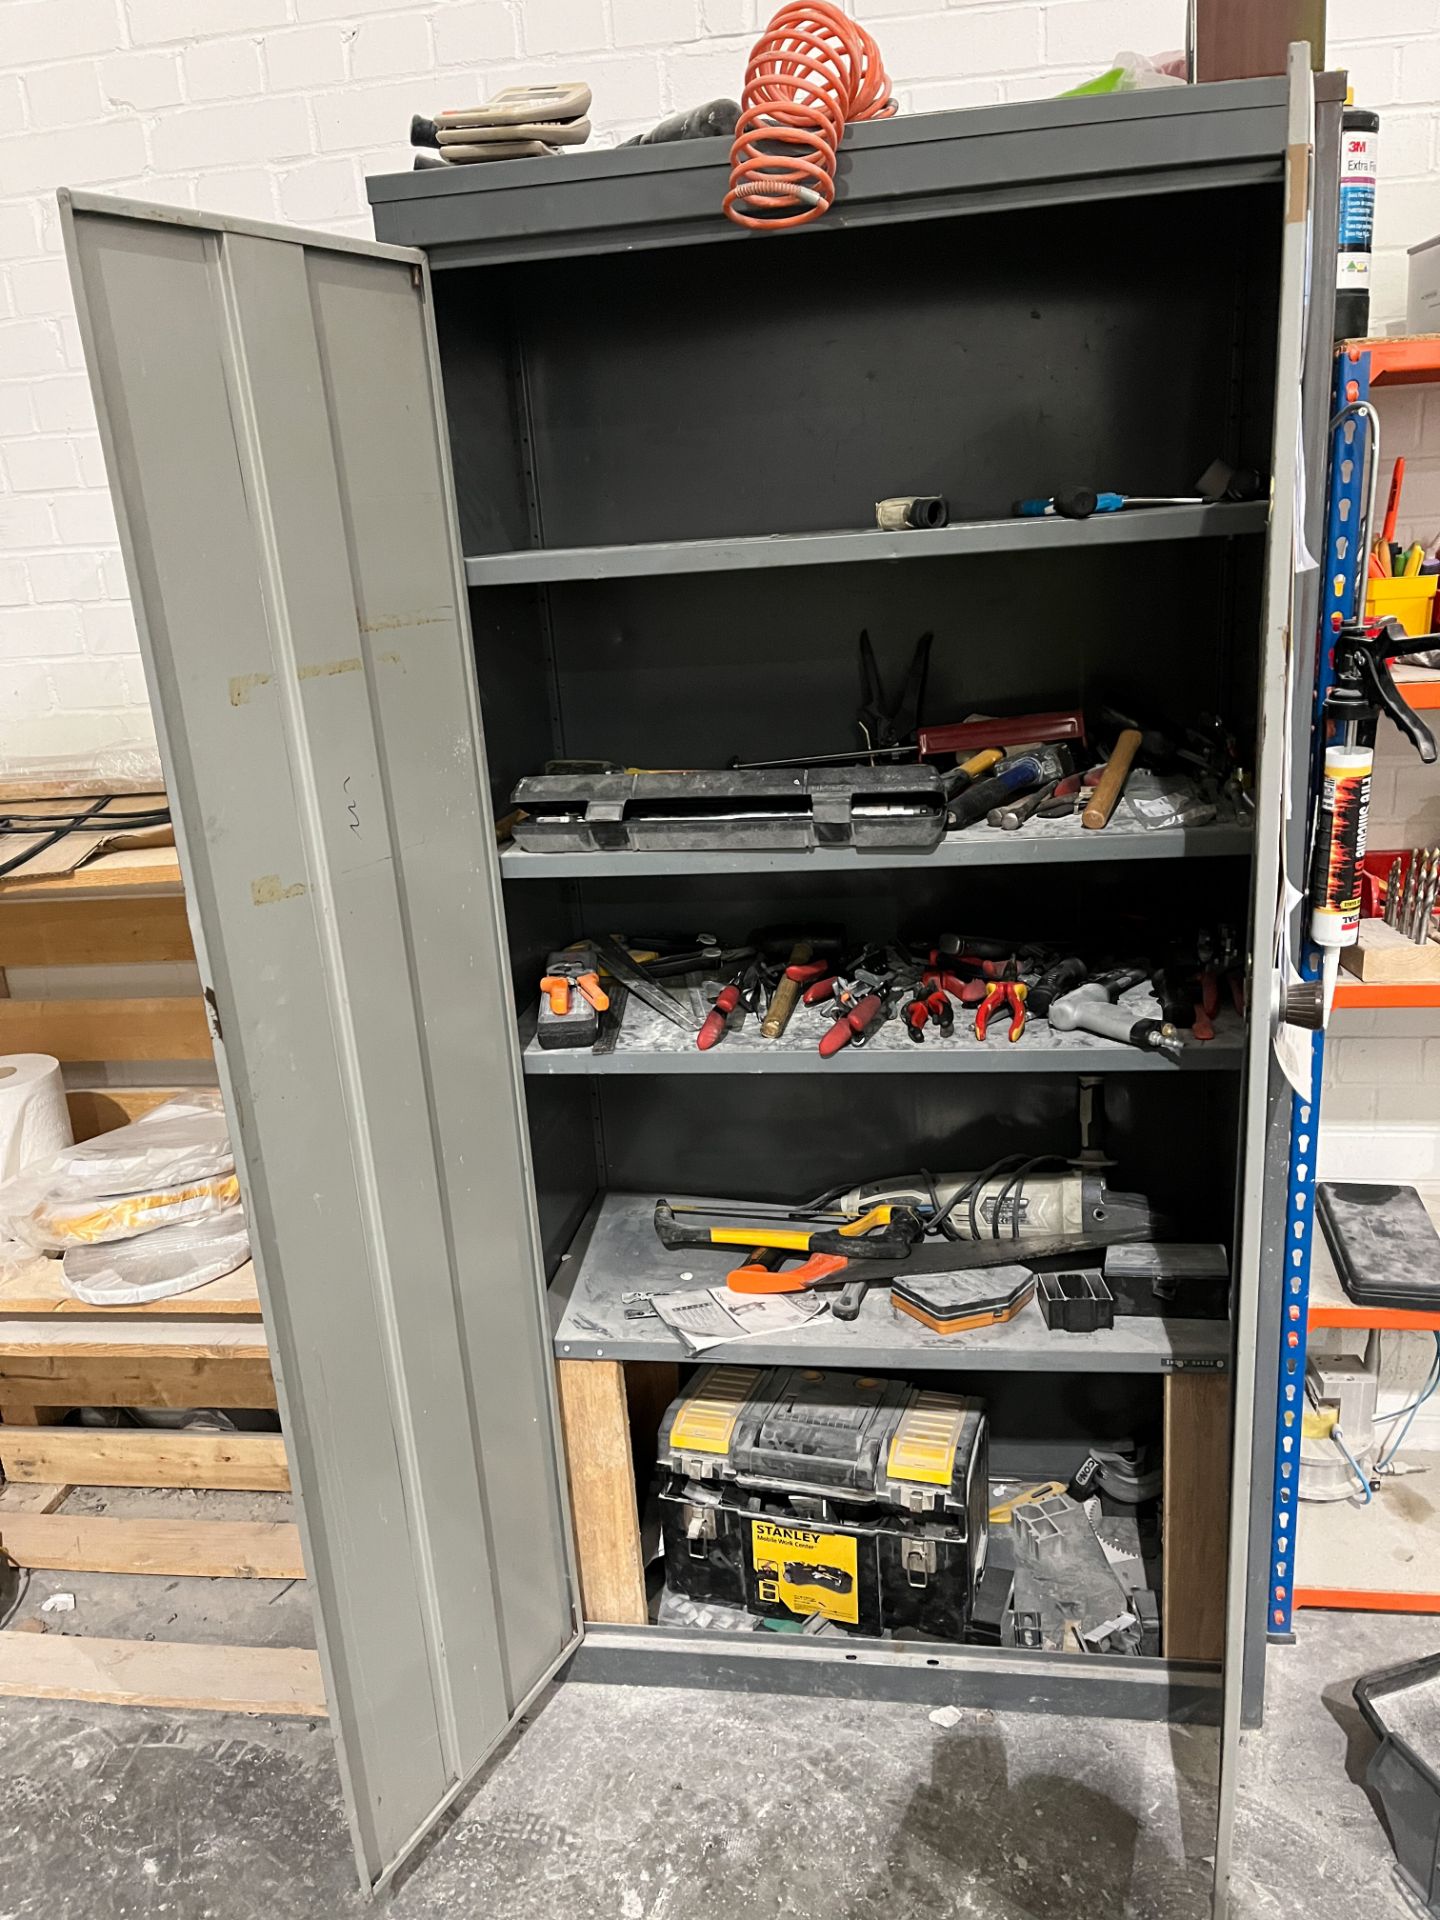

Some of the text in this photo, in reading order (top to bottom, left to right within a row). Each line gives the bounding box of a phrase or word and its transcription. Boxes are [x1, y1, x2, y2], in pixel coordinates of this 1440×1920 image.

[1348, 141, 1366, 152] 3M
[1348, 160, 1368, 171] Extra
[757, 1525, 820, 1543] STANLEY
[757, 1535, 777, 1543] Mobile
[778, 1538, 793, 1546] Work
